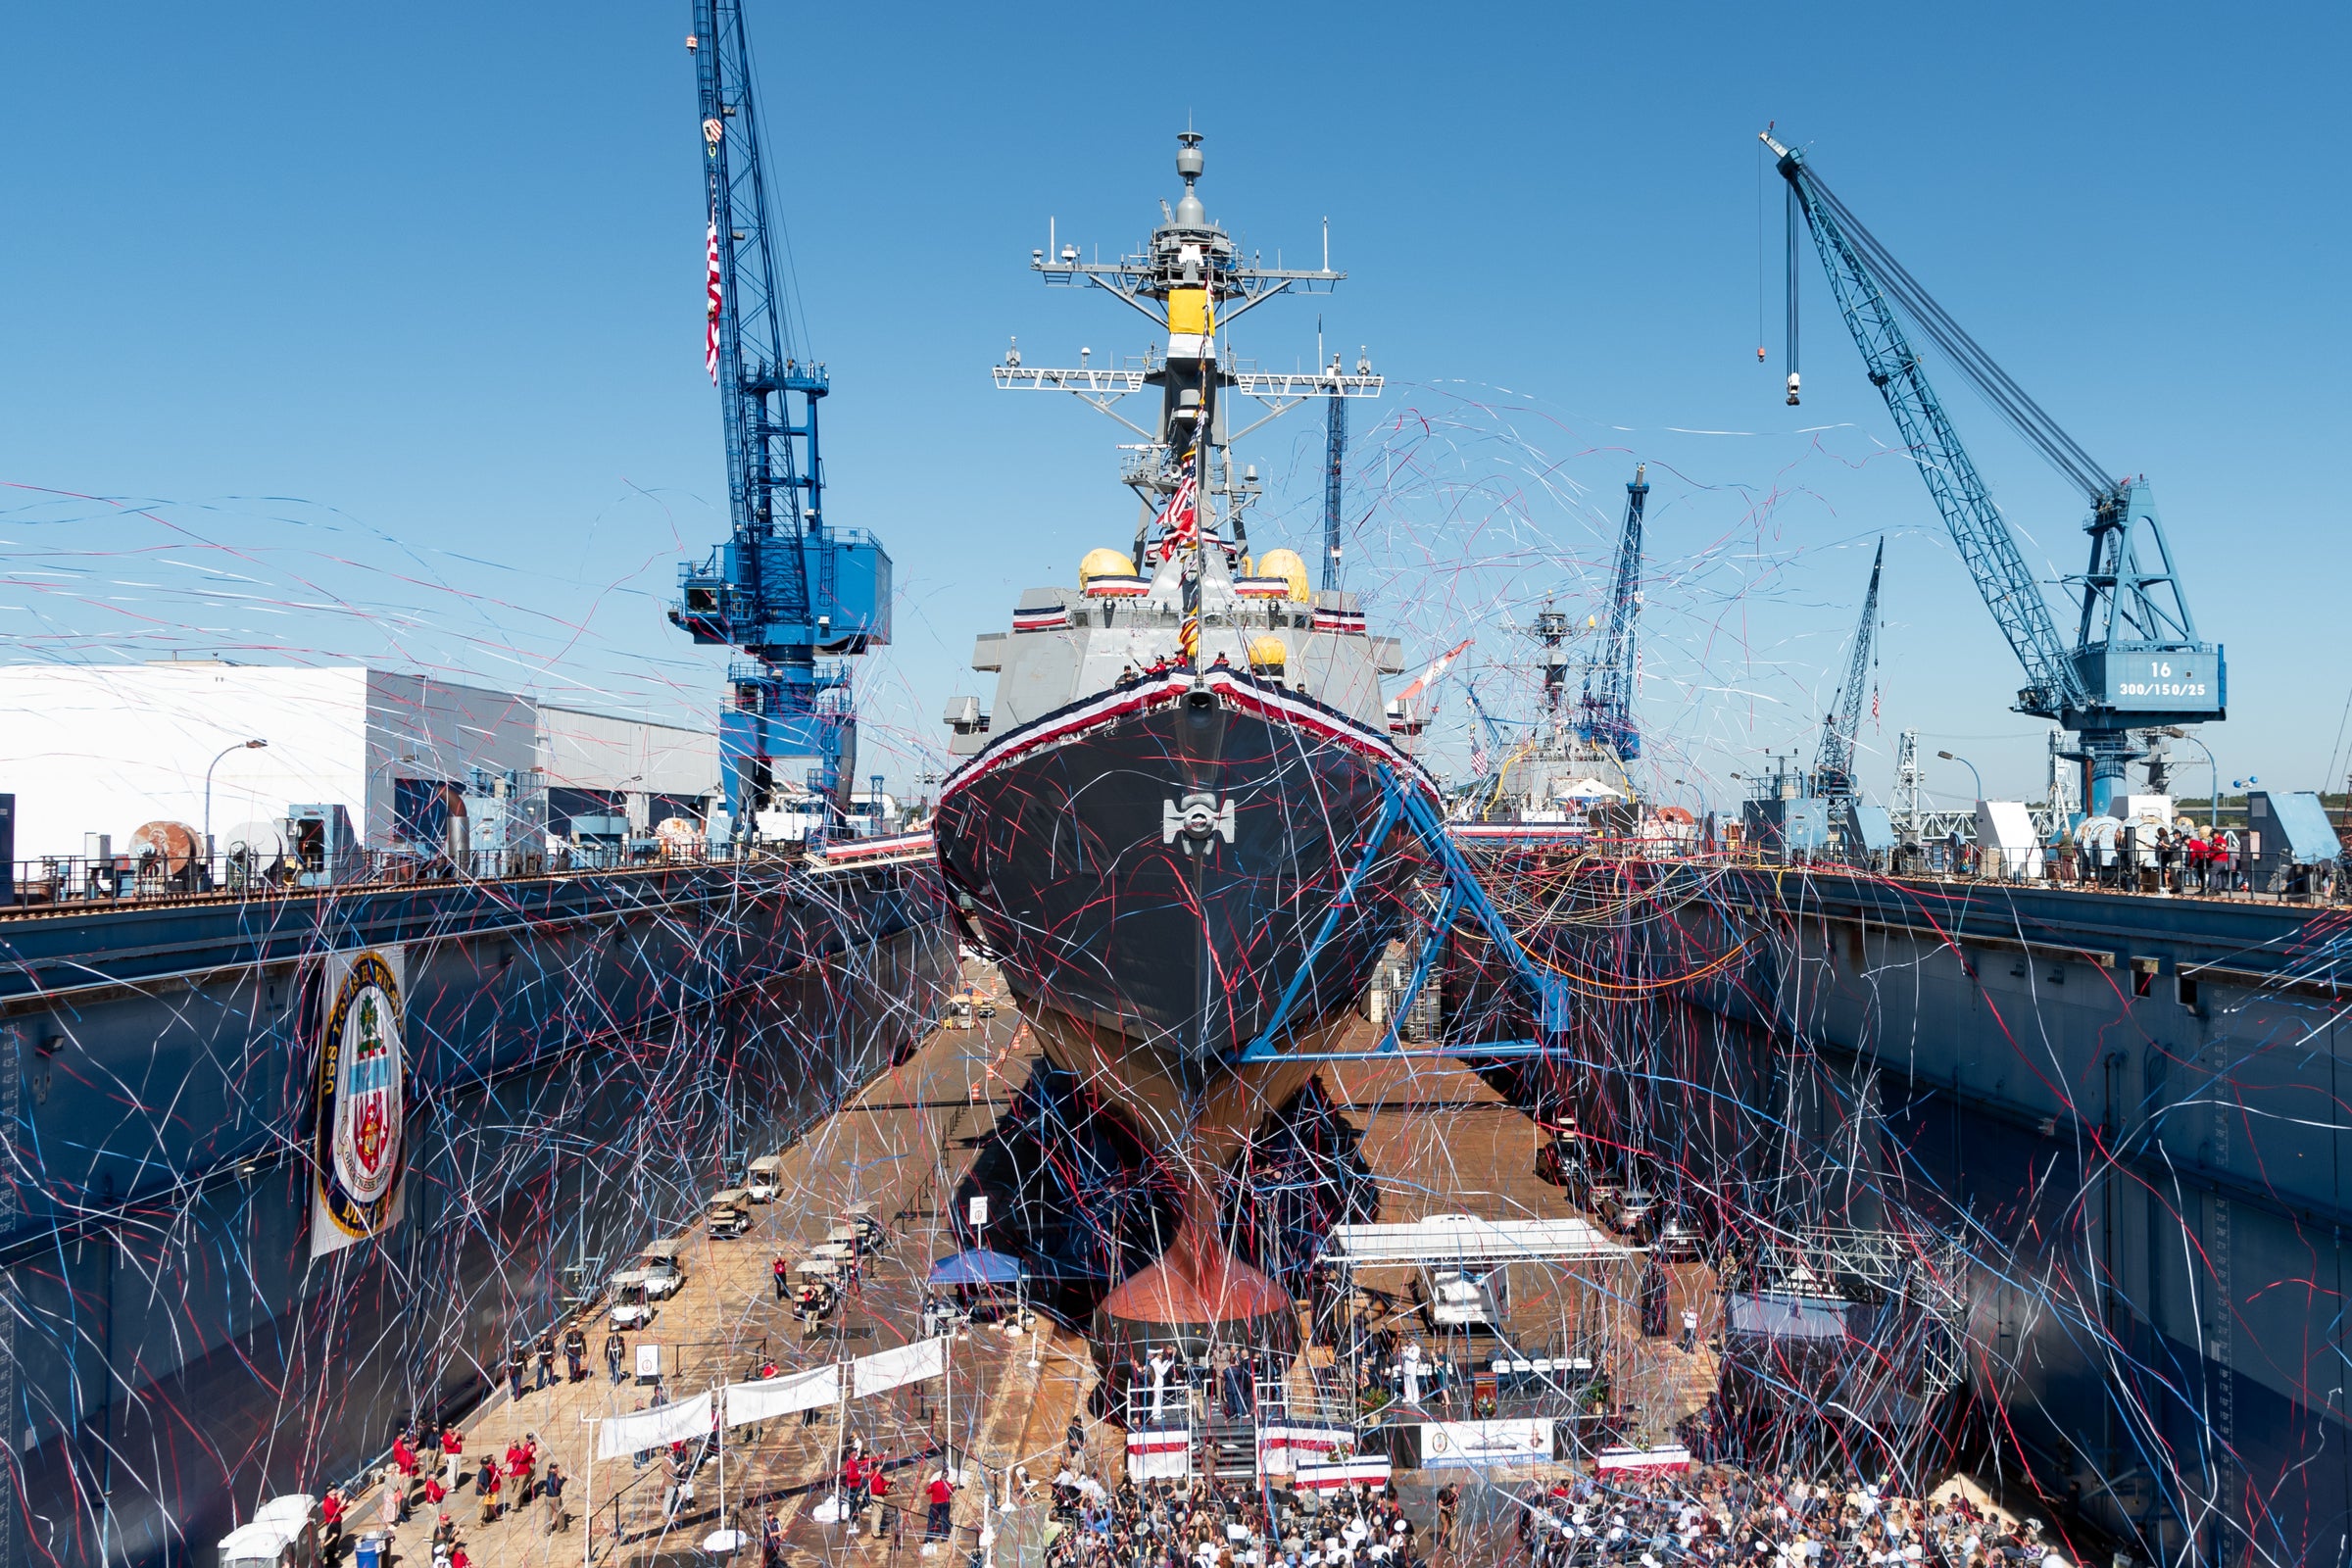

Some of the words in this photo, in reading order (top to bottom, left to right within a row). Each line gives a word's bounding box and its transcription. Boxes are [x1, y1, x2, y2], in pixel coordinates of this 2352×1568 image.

[2151, 662, 2172, 678] 16
[2119, 683, 2206, 697] 300/150/25
[323, 1045, 338, 1096] USS
[332, 971, 360, 1038] LOIS
